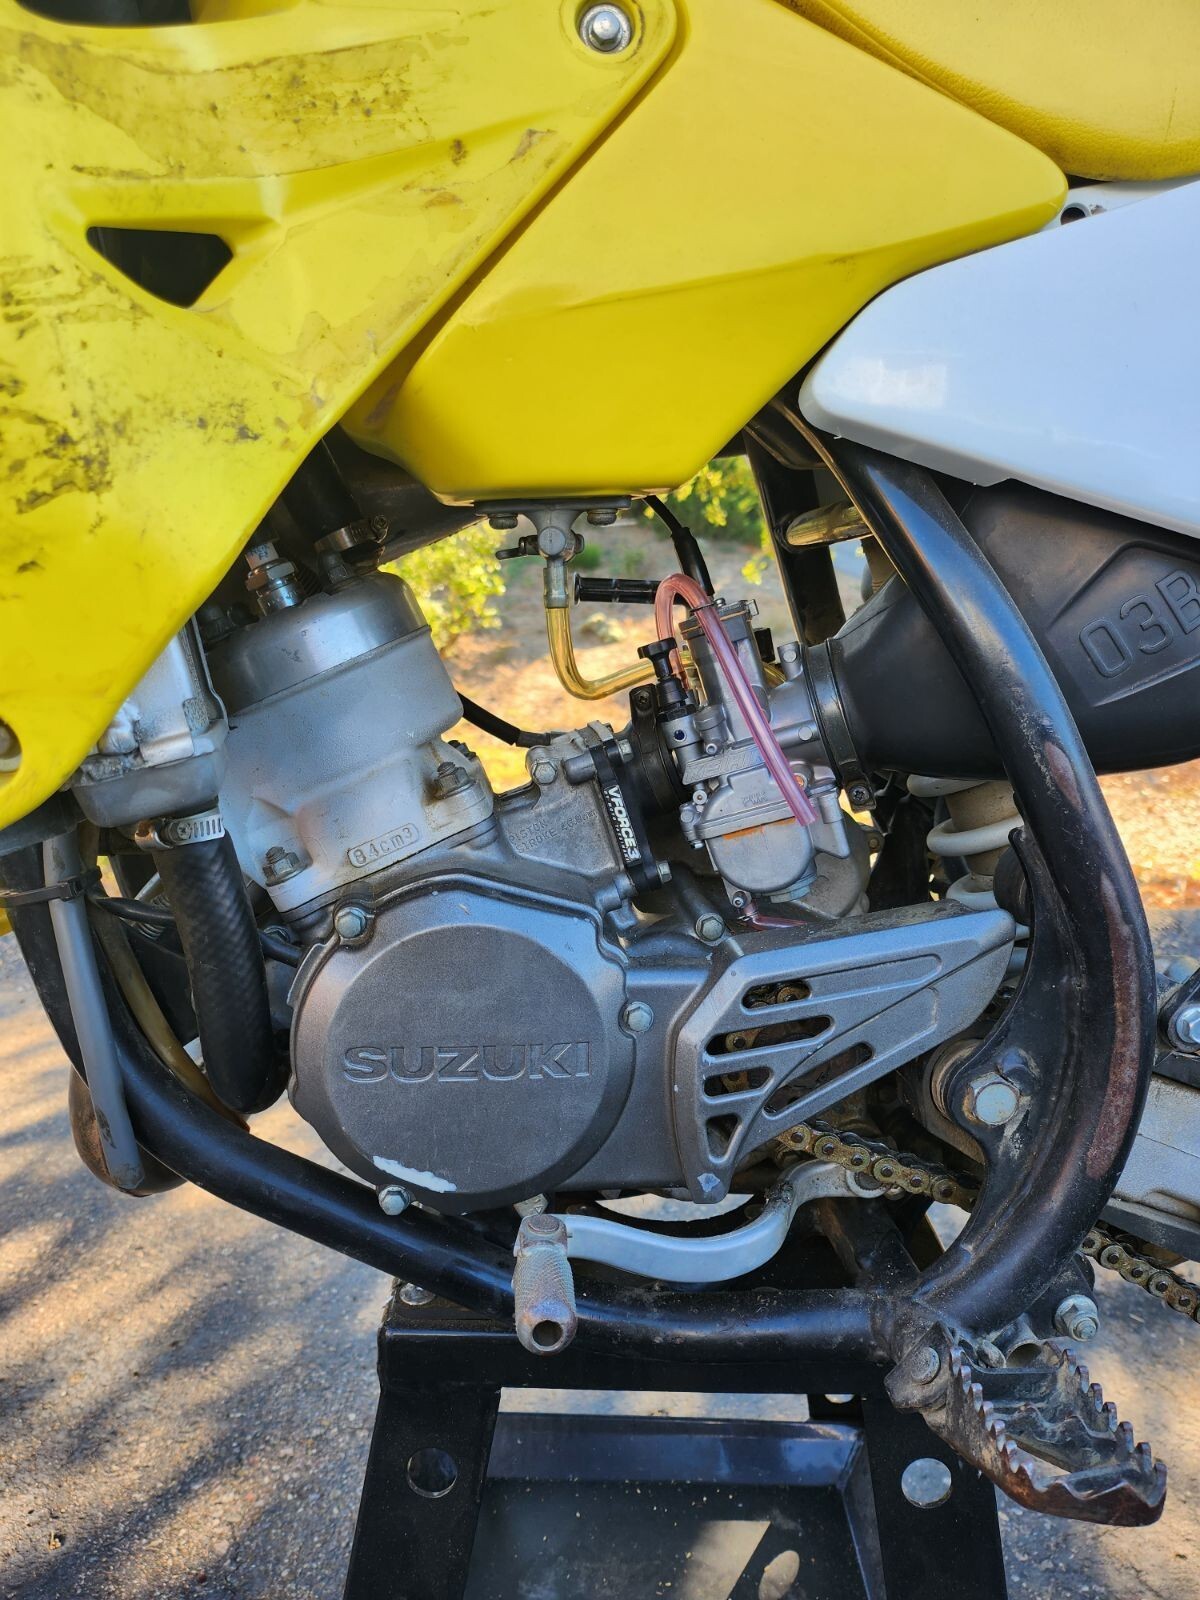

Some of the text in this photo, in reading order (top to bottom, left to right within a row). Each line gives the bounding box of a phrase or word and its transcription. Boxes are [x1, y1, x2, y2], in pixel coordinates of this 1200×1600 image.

[1079, 569, 1200, 678] 03B
[509, 819, 549, 845] PISTON
[515, 828, 558, 853] STROKE
[343, 1041, 591, 1083] SUZUKI
